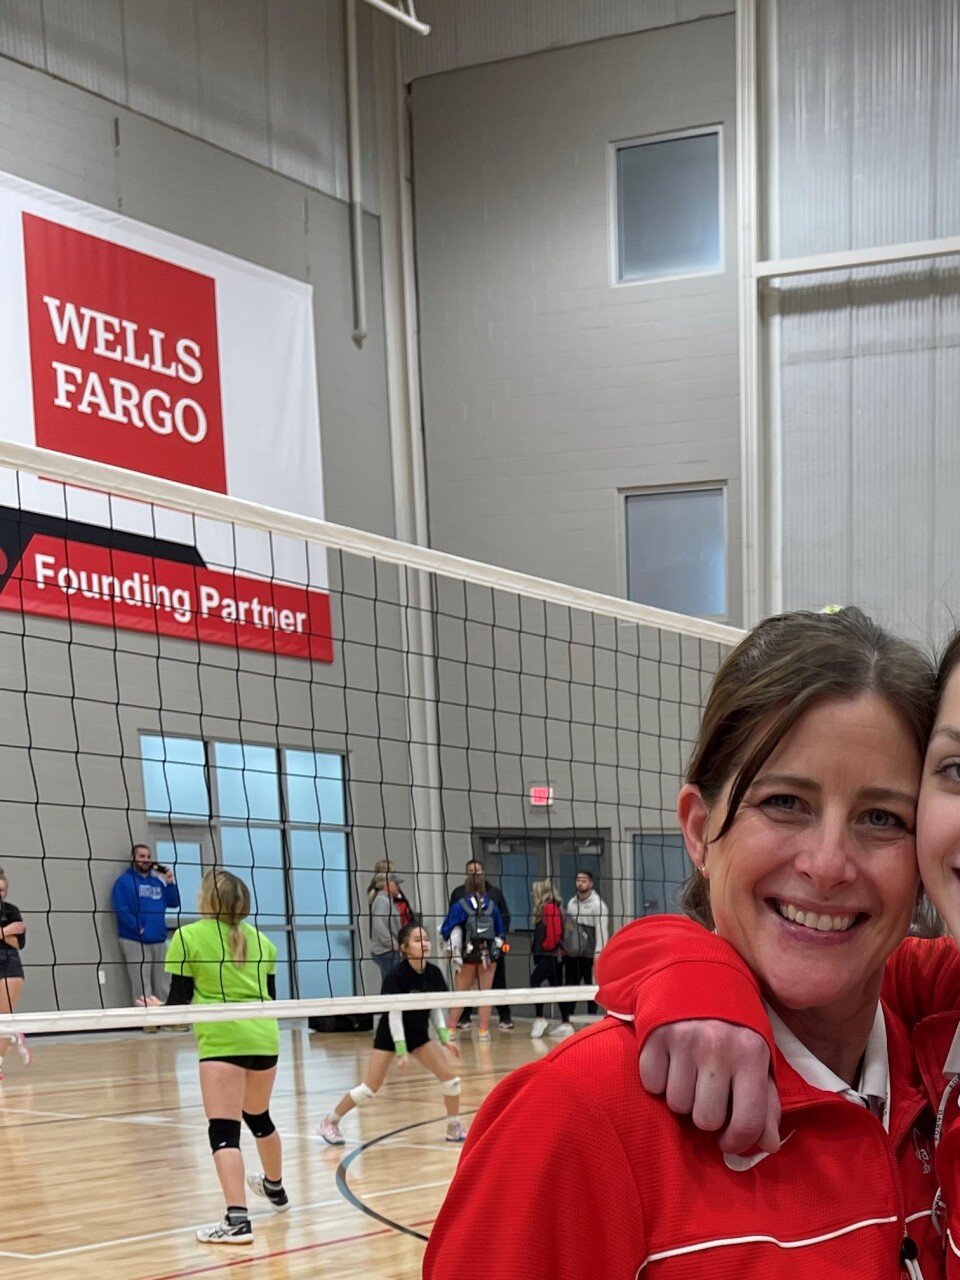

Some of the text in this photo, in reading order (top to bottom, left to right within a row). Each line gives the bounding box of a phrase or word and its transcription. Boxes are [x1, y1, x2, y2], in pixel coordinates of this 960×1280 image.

[43, 295, 204, 385] WELLS
[52, 361, 208, 444] FARGO
[34, 553, 308, 633] Founding Partner
